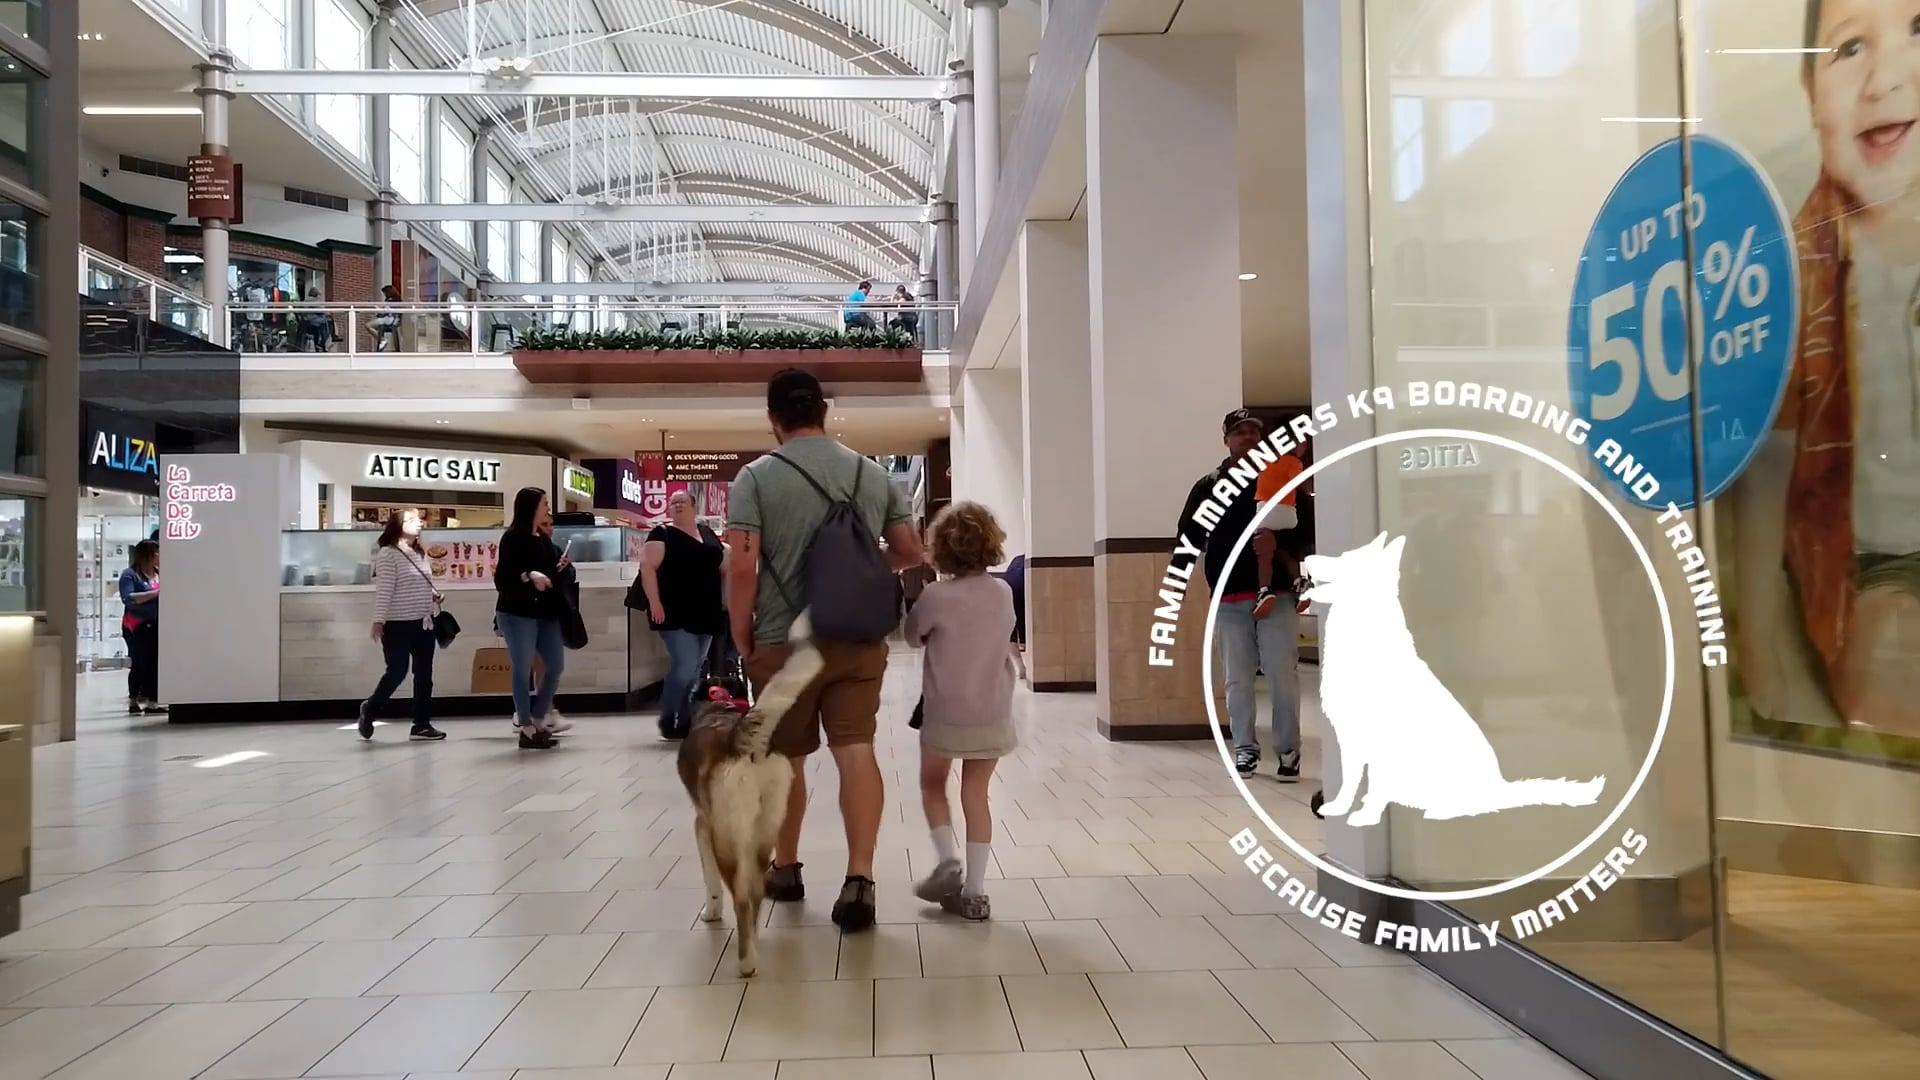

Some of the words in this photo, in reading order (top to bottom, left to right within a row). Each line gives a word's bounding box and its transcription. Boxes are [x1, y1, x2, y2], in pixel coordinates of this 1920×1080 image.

[1620, 216, 1658, 261] UP
[1663, 192, 1706, 241] TO
[1709, 315, 1771, 367] OFF
[90, 431, 159, 476] ALIZA
[692, 453, 719, 461] SPORTING
[719, 453, 739, 461] GOODS
[167, 464, 190, 483] La
[369, 454, 440, 480] ATTIC
[446, 459, 502, 482] SALT
[675, 463, 690, 471] AMC
[690, 463, 719, 471] THEATRES
[675, 473, 692, 481] FOOD
[167, 483, 236, 502] Carreta
[167, 502, 192, 520] De
[167, 520, 201, 540] Lily
